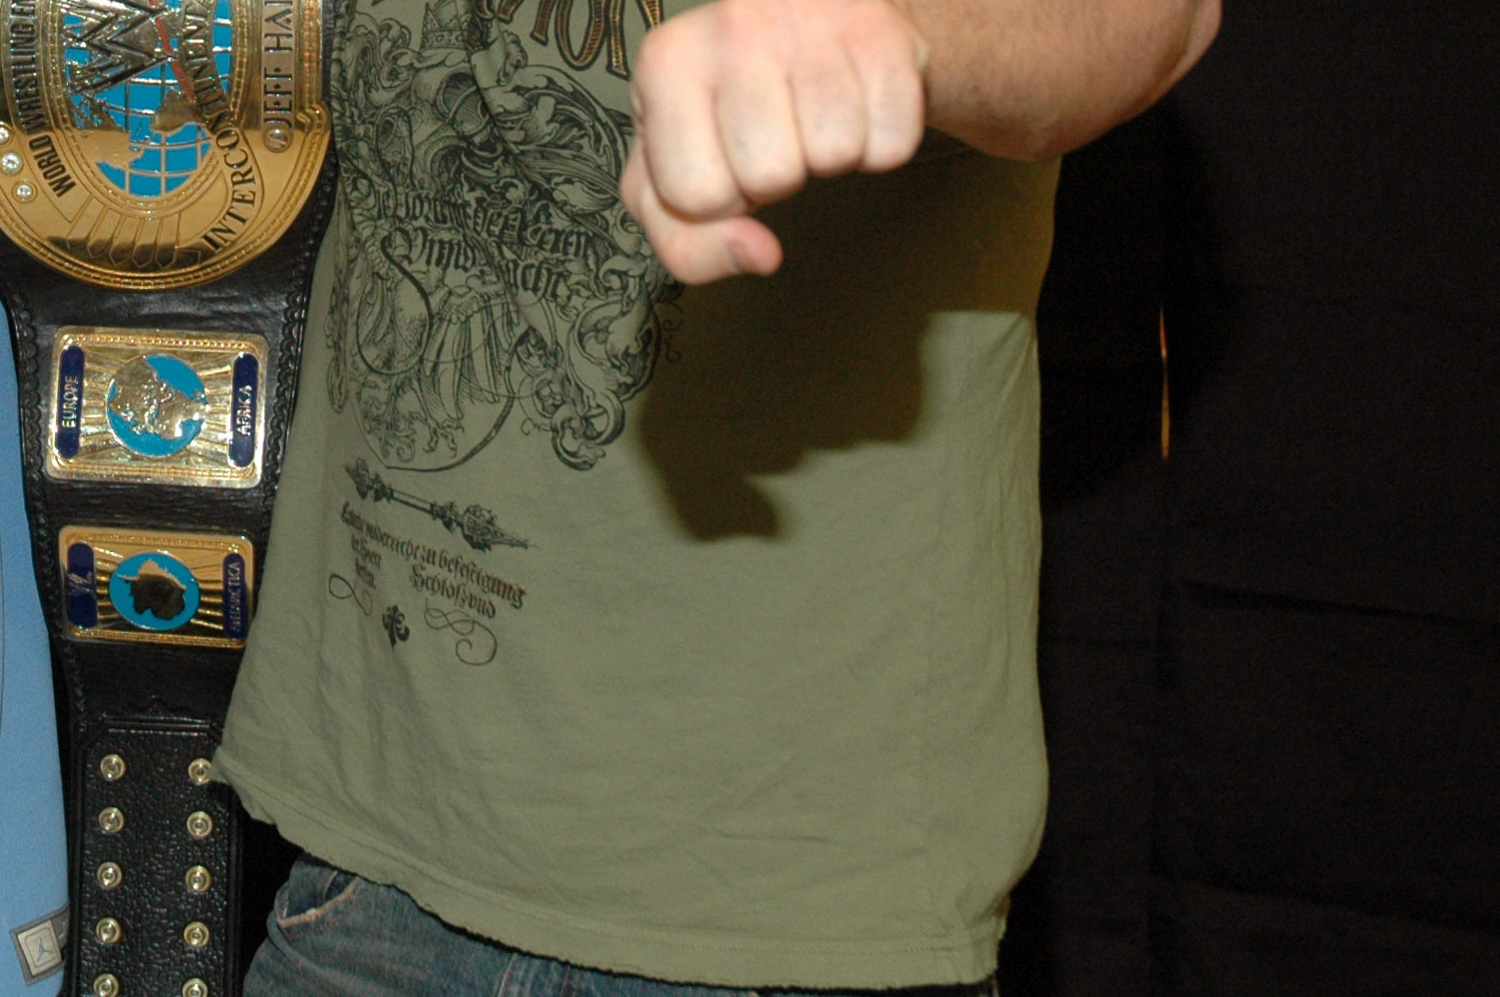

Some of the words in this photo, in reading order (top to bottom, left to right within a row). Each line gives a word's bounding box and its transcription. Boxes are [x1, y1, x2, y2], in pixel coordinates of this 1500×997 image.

[9, 20, 48, 134] WRESTLING
[263, 67, 293, 129] JEFF
[29, 134, 77, 198] WORLD
[61, 375, 78, 429] EUROPE
[236, 384, 253, 436] AFRICA
[227, 561, 242, 633] ANTARCTICA
